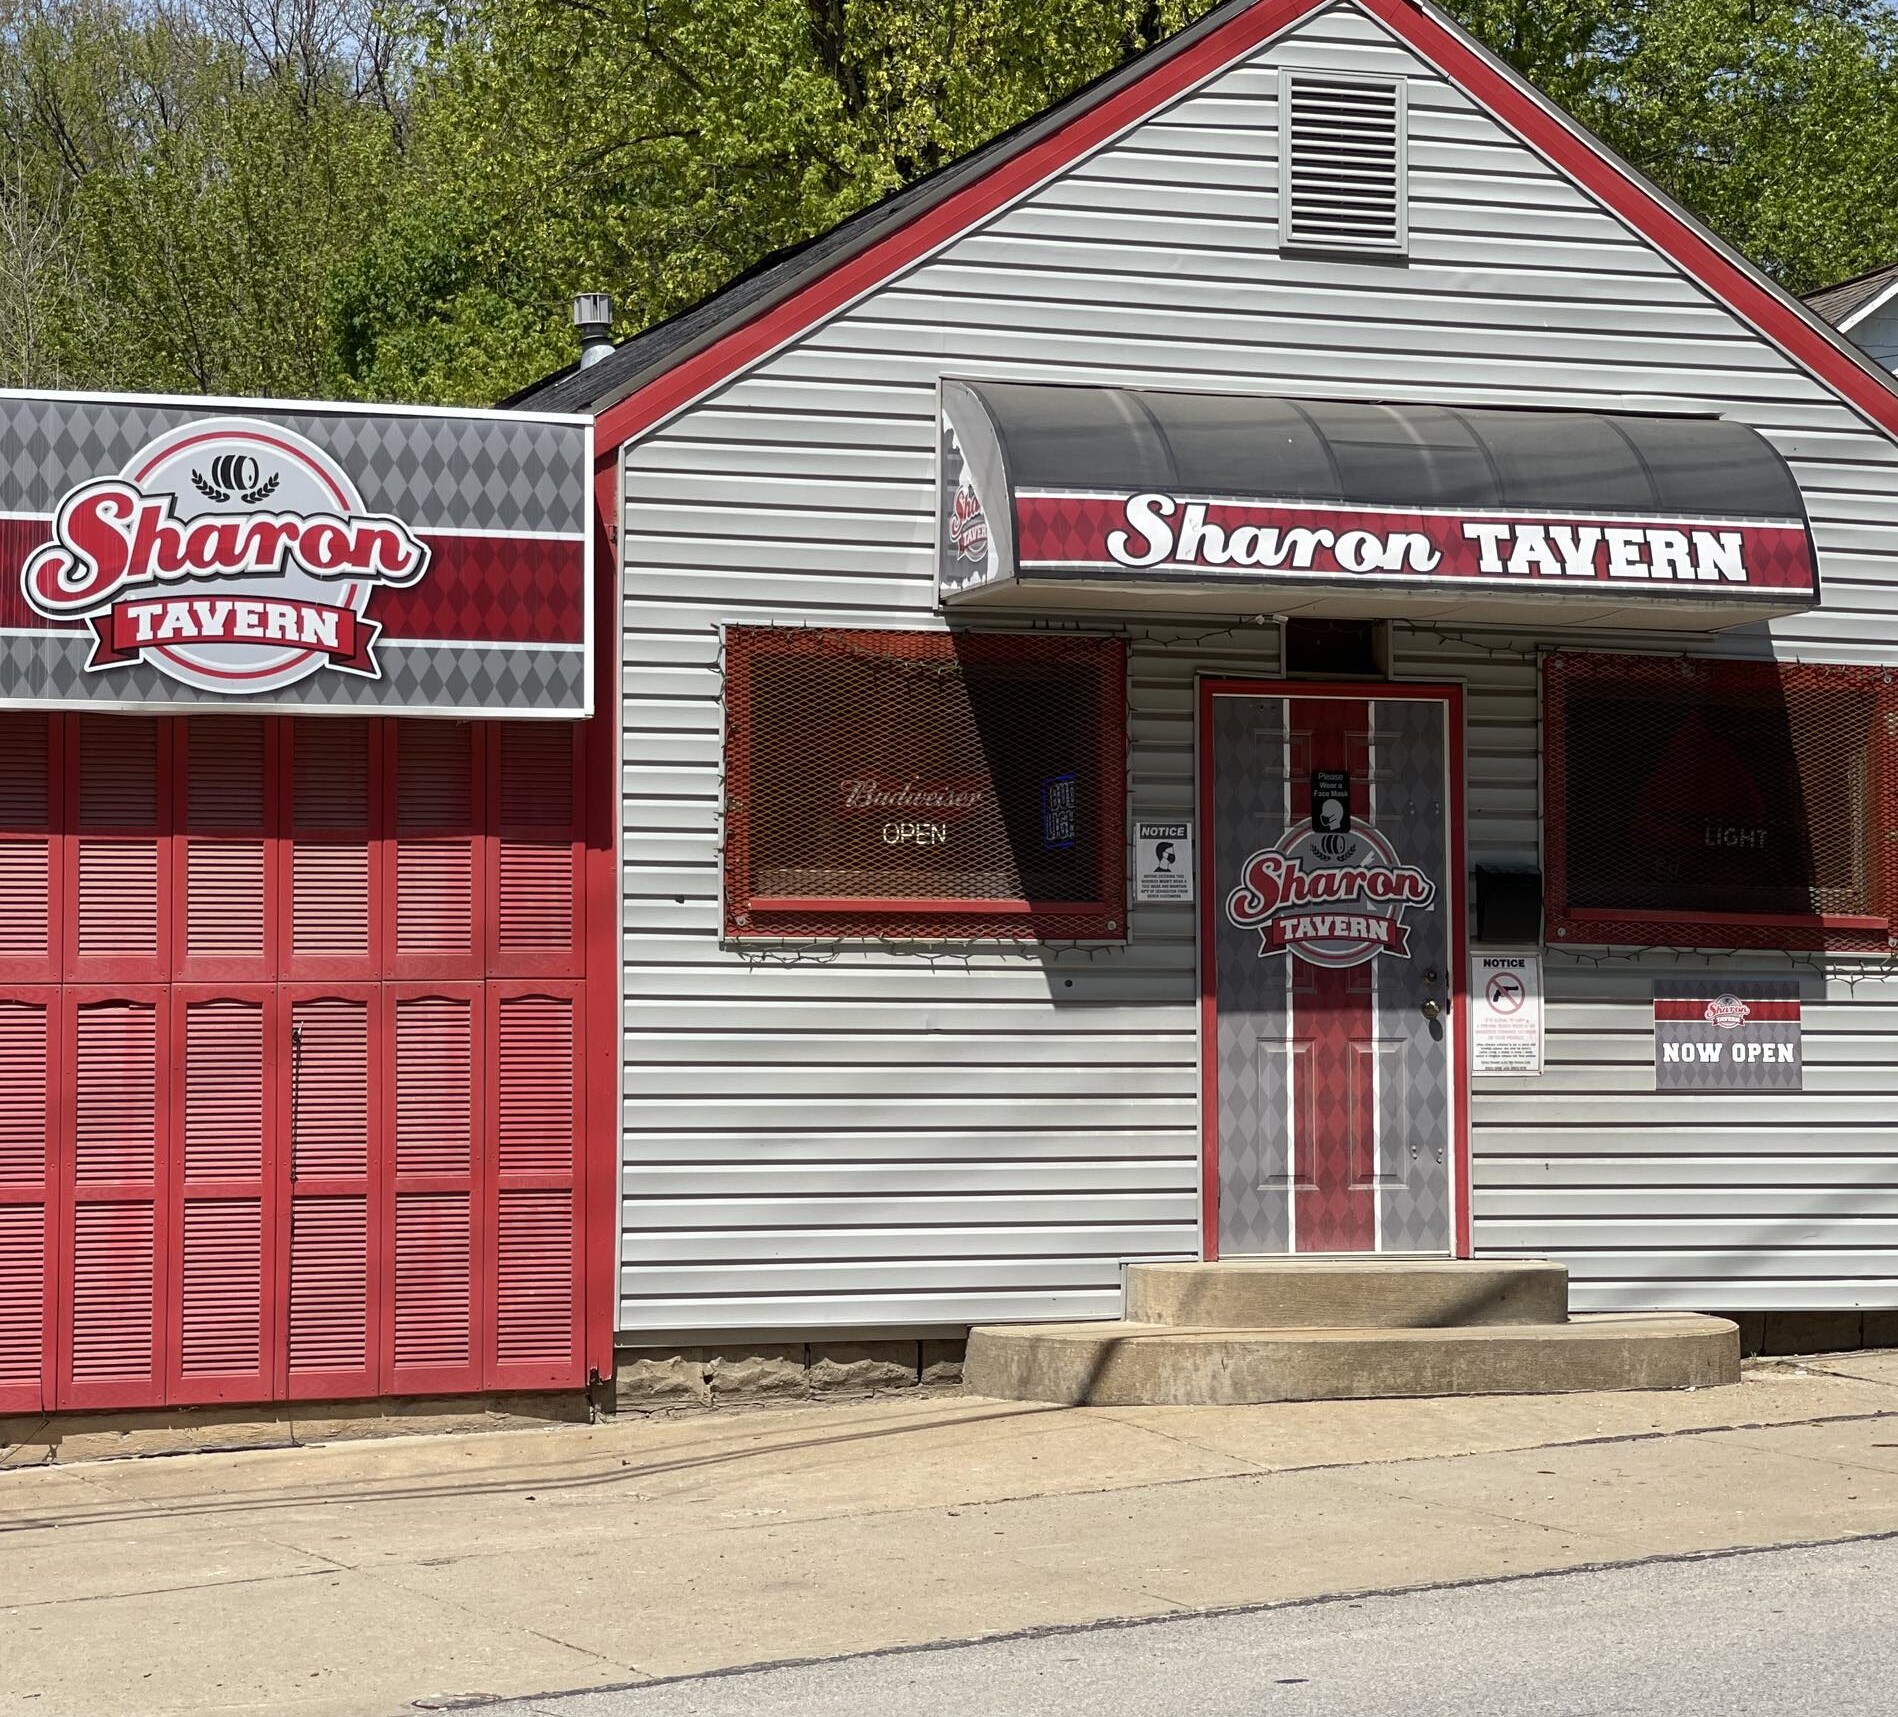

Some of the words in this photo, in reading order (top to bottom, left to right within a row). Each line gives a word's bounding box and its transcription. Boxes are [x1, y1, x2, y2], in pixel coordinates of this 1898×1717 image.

[28, 483, 424, 610] Sharon
[1106, 492, 1442, 573] Sharon
[1462, 522, 1748, 582] TAVERN
[126, 600, 339, 649] TAVERN
[1318, 772, 1344, 781] Please
[1319, 781, 1337, 789] Wear
[840, 777, 982, 808] Budweiser
[1313, 789, 1330, 797] Face
[882, 822, 947, 845] OPEN
[1141, 826, 1185, 837] NOTICE
[1704, 823, 1769, 849] LIGHT
[1230, 852, 1431, 924] Sharon
[1279, 916, 1390, 941] TAVERN
[1483, 958, 1526, 968] NOTICE
[1705, 1002, 1750, 1020] Sharon
[1663, 1042, 1723, 1063] NOW
[1731, 1042, 1795, 1063] OPEN
